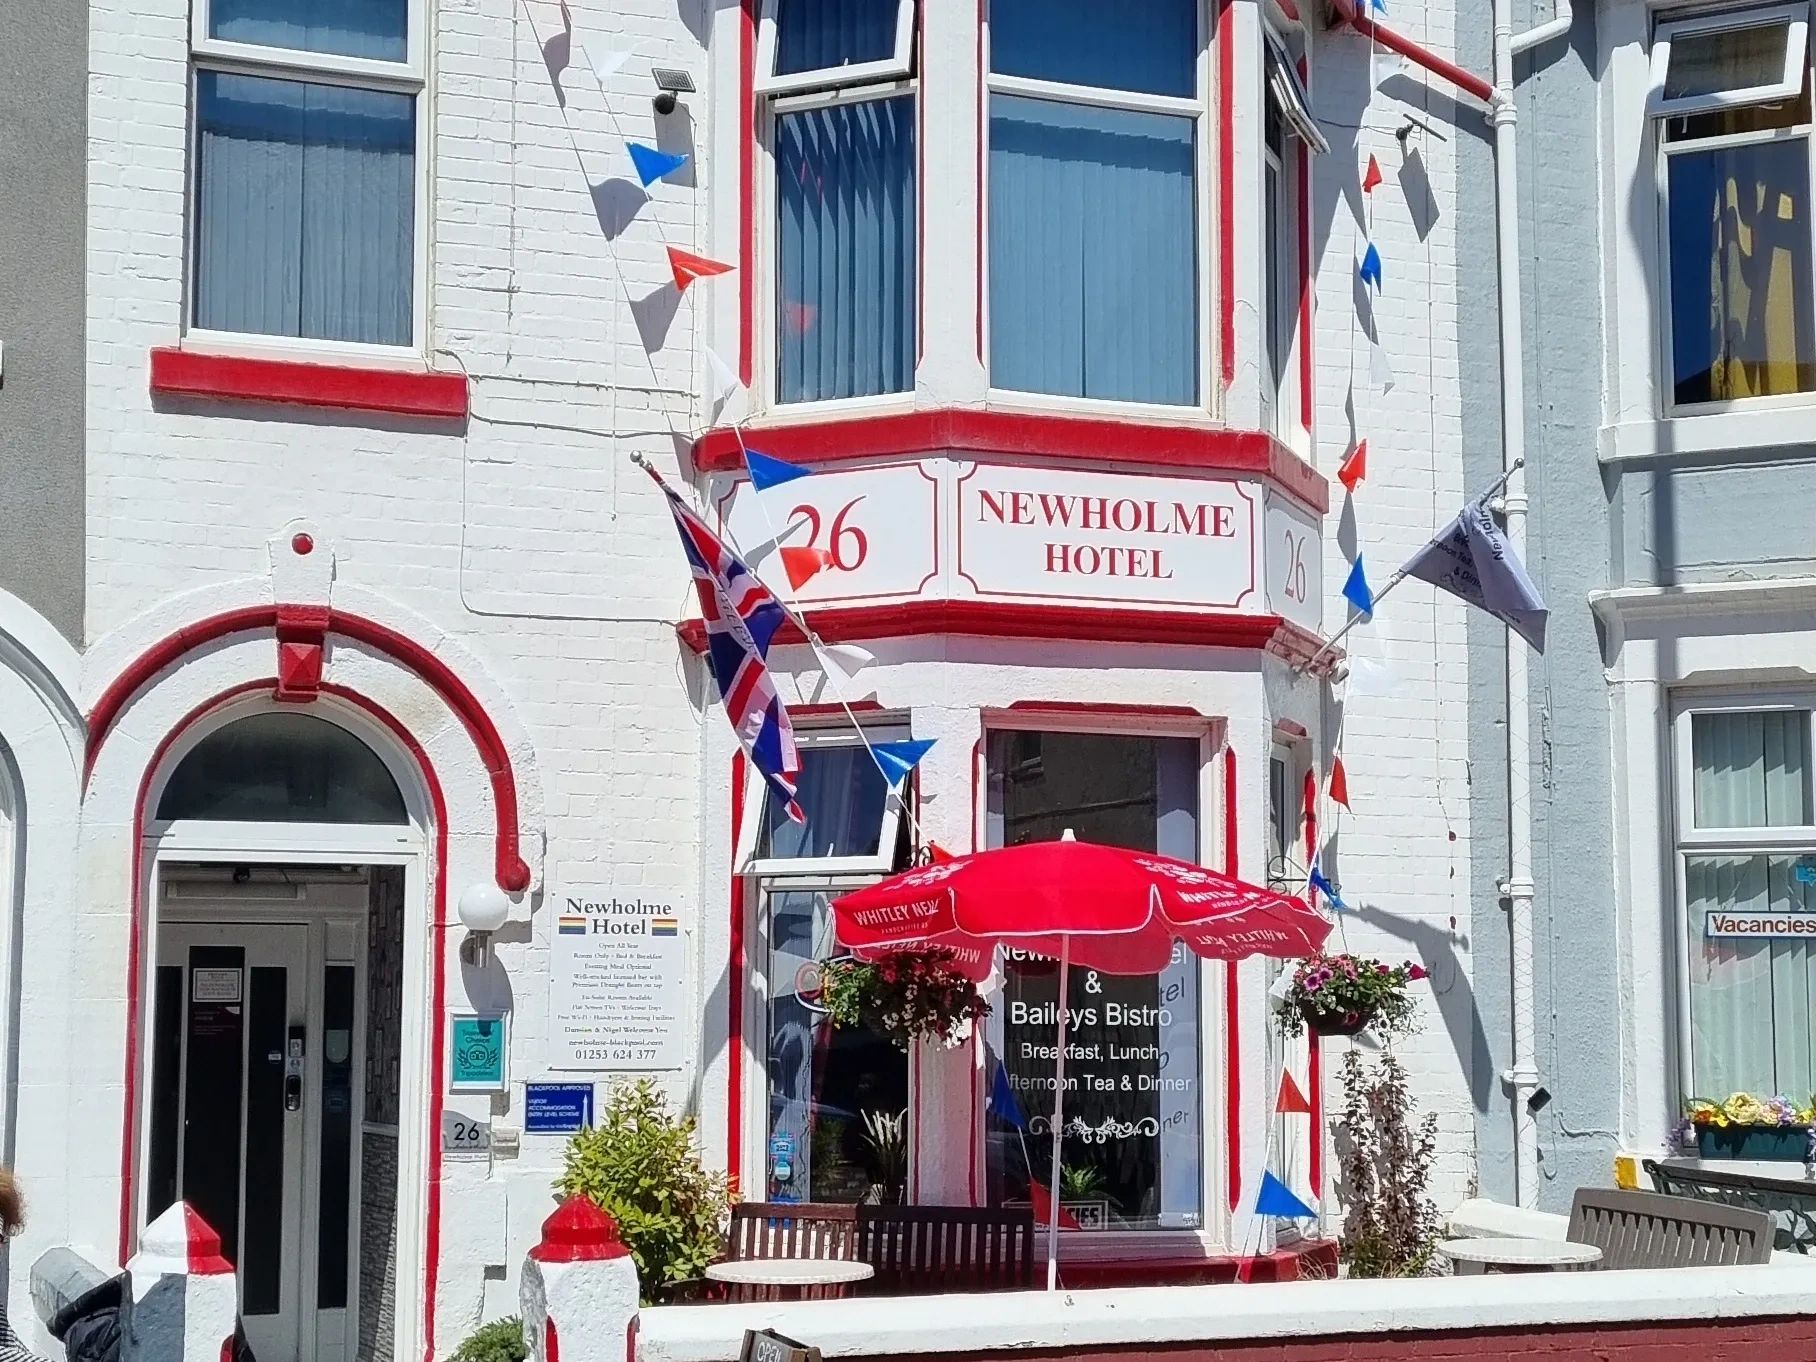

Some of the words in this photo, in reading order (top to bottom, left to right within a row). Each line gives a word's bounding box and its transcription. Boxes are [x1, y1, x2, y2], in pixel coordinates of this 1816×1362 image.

[976, 488, 1236, 539] NEWHOLME
[785, 494, 868, 572] 26
[1044, 543, 1174, 580] HOTEL
[1284, 529, 1306, 604] 26
[565, 898, 672, 915] Newholme
[853, 904, 910, 926] WHITLEY
[591, 918, 646, 935] Hotel
[1712, 914, 1816, 934] Vacancies
[1085, 970, 1102, 994] &
[1011, 1001, 1098, 1032] Baileys
[1105, 1002, 1173, 1027] Bistro
[575, 1049, 608, 1060] 01253
[613, 1049, 632, 1060] 624
[636, 1050, 657, 1060] 377
[1020, 1042, 1104, 1062] Breakfast,
[1110, 1042, 1159, 1060] Lunch
[1008, 1073, 1078, 1091] fternoon
[1082, 1074, 1115, 1091] Tea
[1120, 1074, 1133, 1091] &
[1138, 1074, 1192, 1091] Dinner
[454, 1122, 480, 1141] 26
